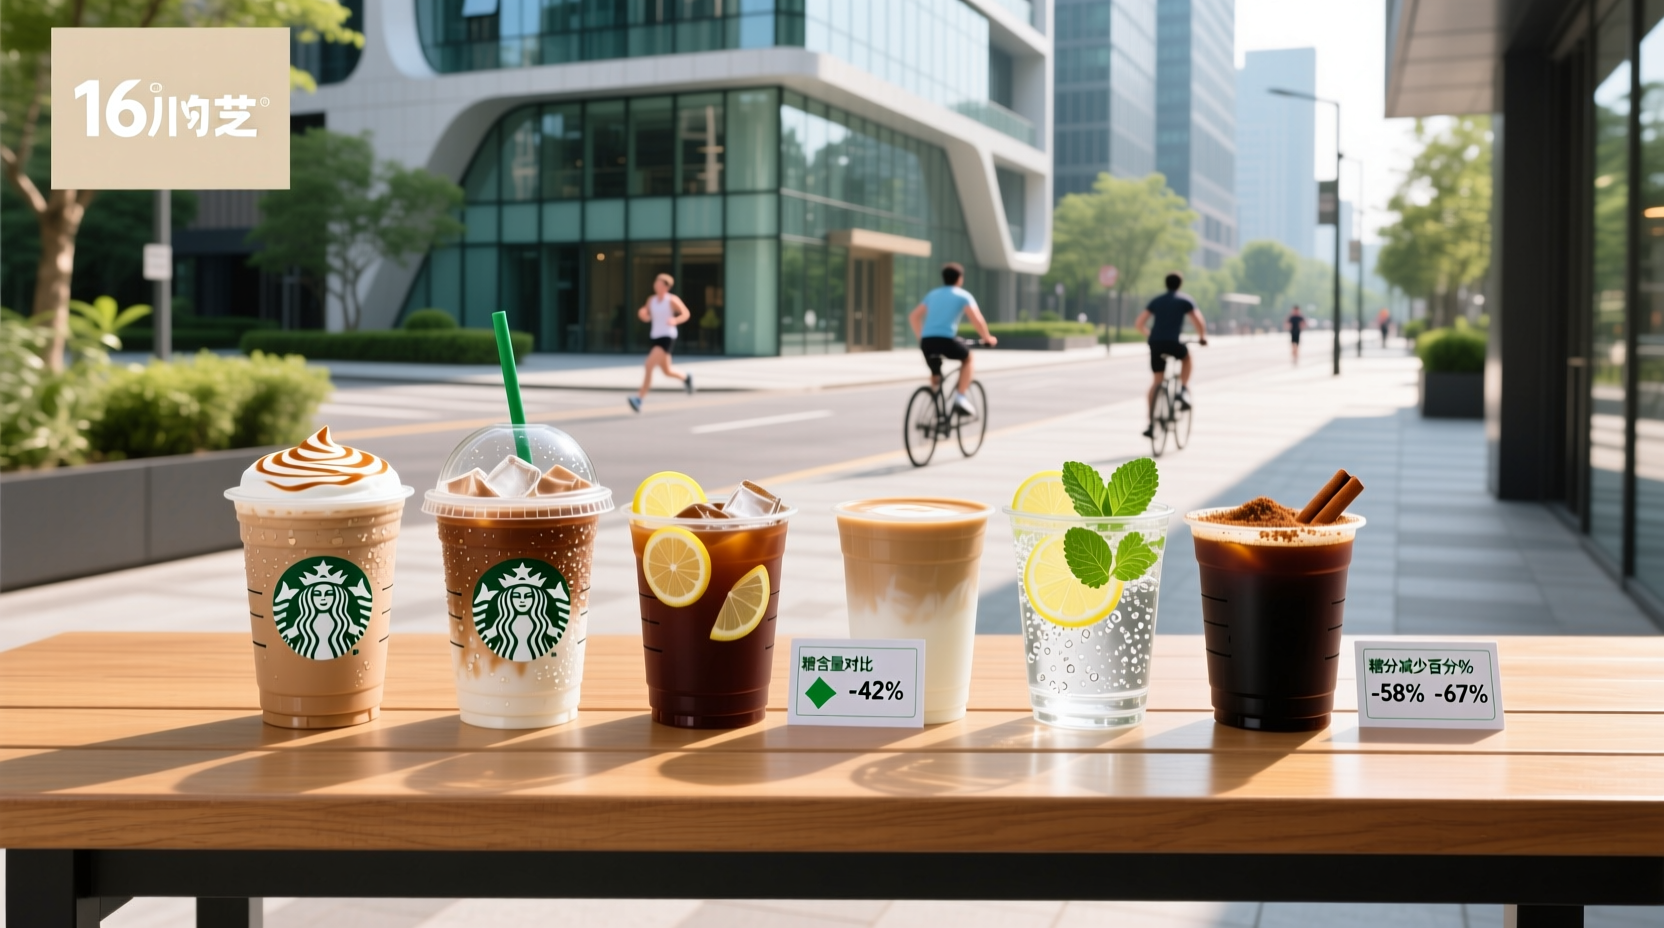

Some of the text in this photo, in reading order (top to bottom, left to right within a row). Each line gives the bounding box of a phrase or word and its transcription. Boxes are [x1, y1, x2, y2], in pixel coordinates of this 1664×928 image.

[848, 680, 904, 701] -42%
[1371, 683, 1489, 704] -58% -67%
